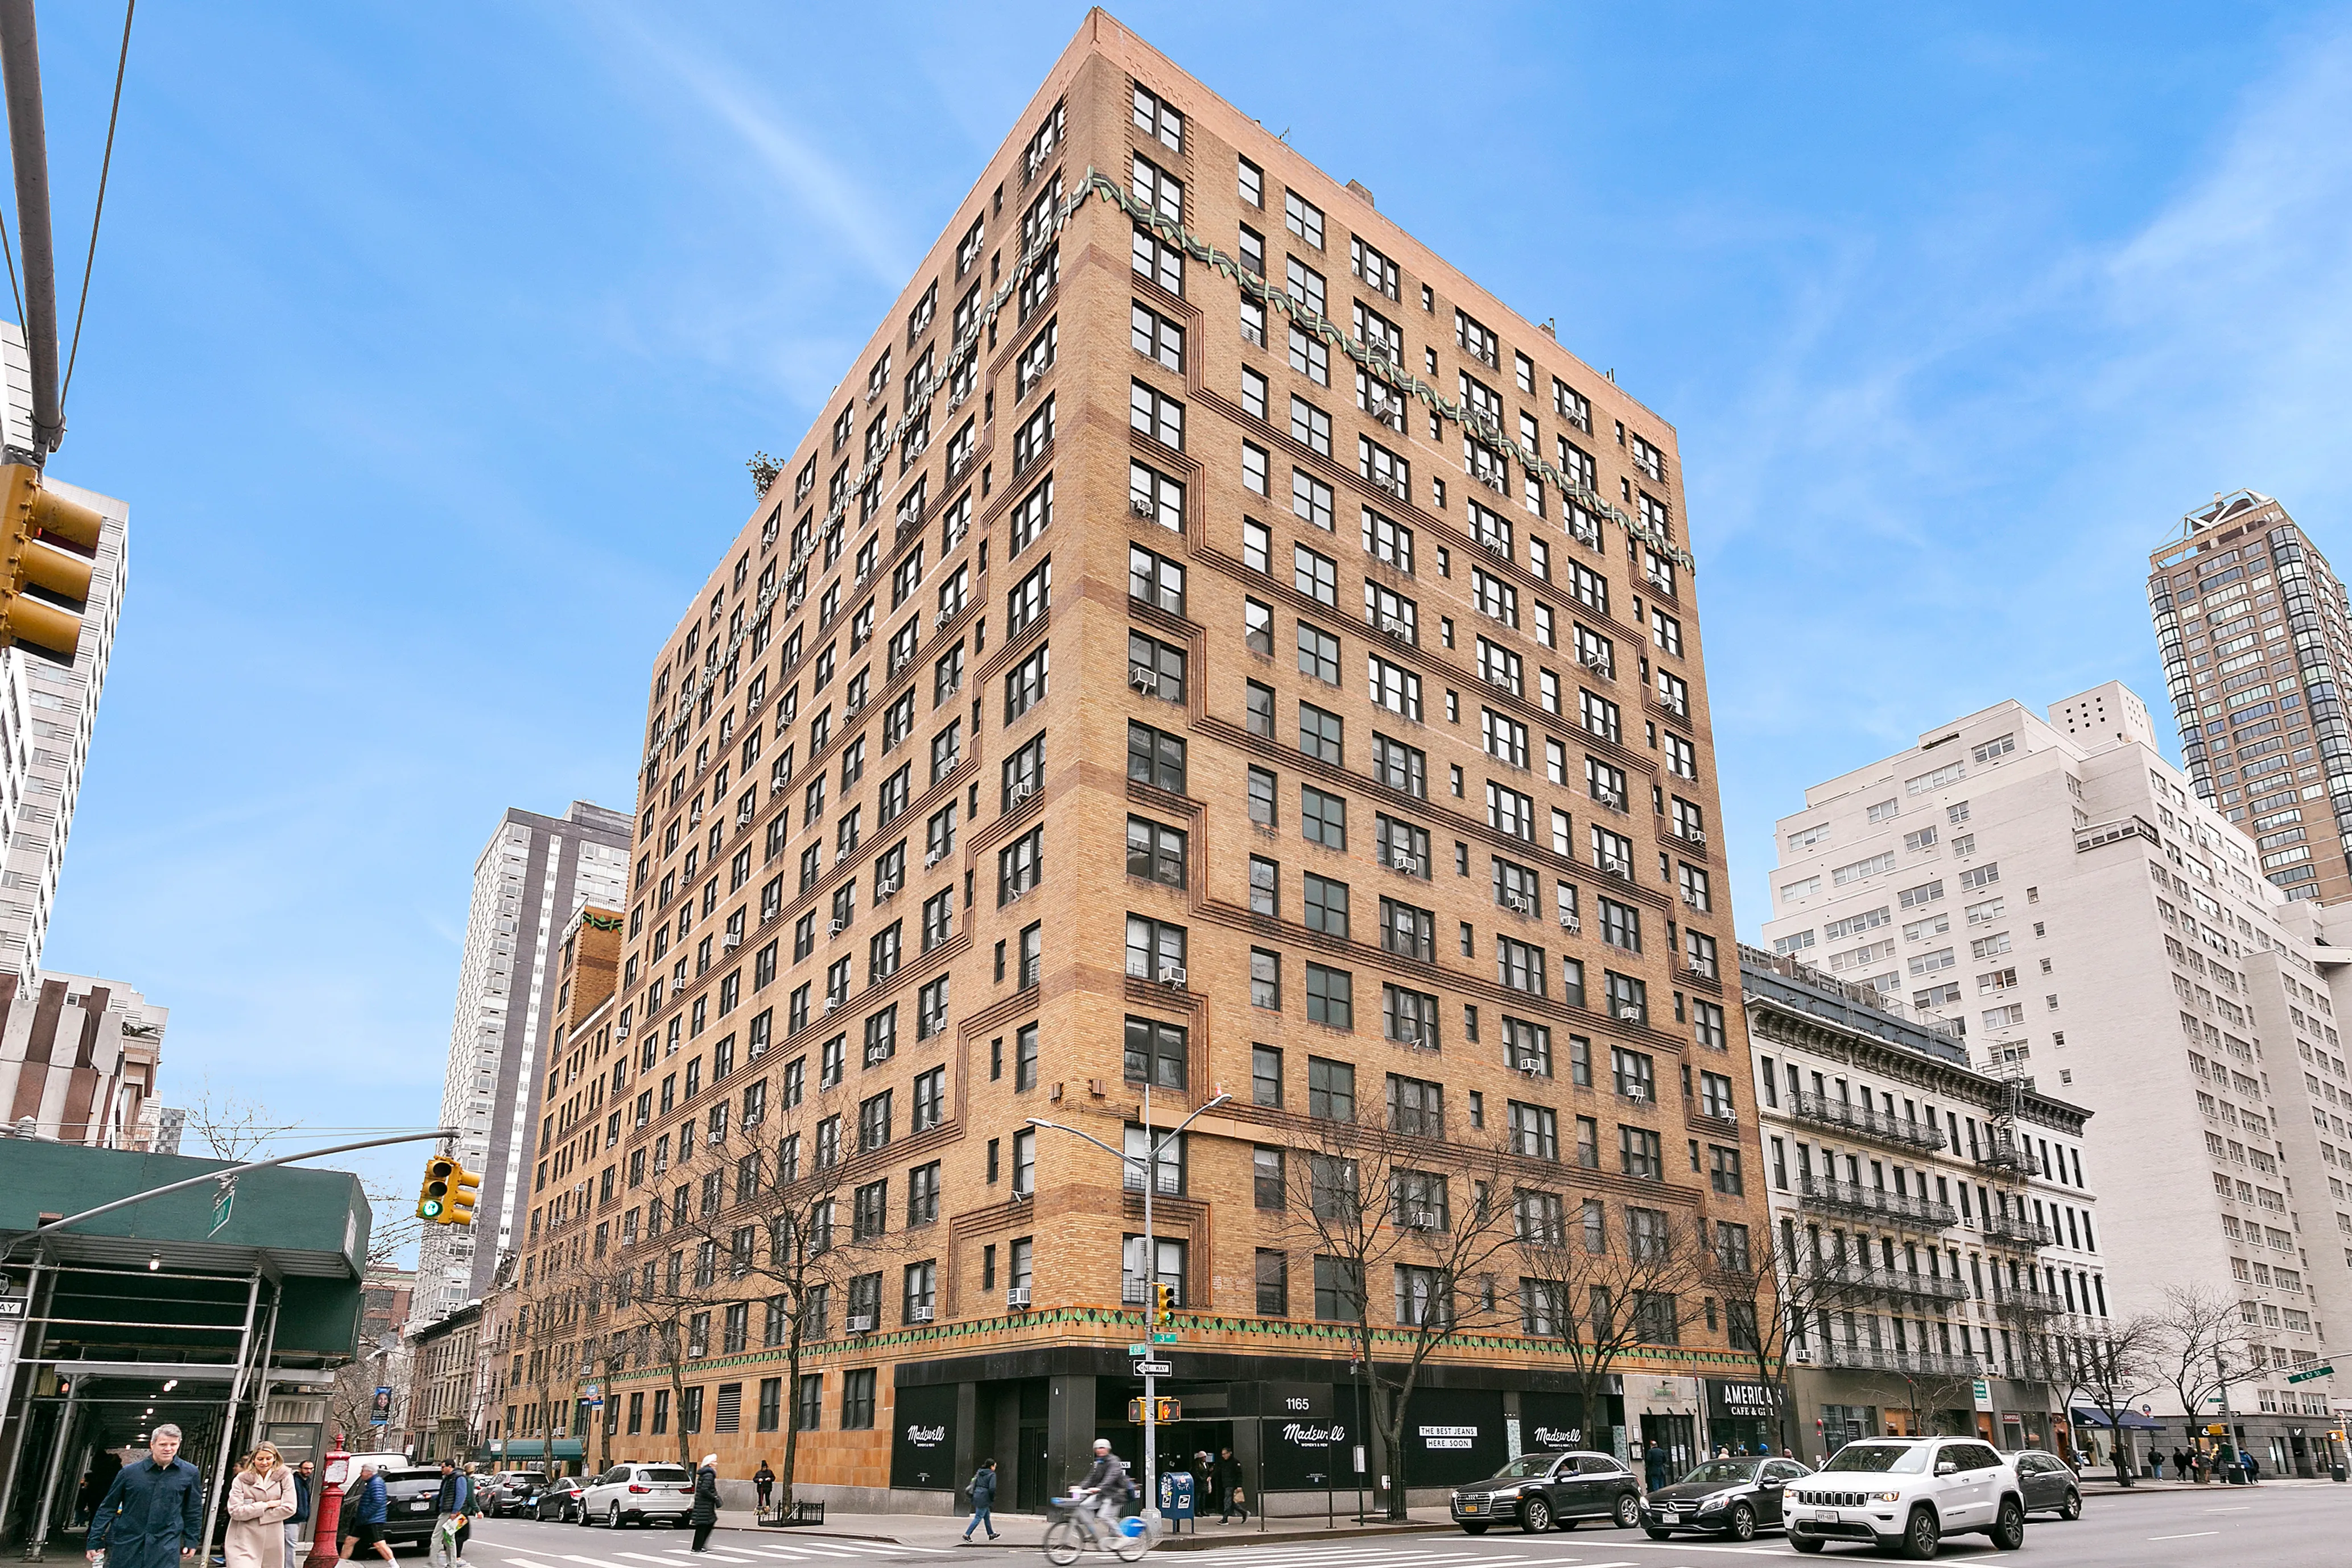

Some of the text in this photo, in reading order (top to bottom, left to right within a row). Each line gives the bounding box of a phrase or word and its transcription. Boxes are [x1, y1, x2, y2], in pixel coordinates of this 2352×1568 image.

[1286, 1398, 1310, 1410] 1165
[1724, 1385, 1782, 1405] AMERICAS
[1731, 1406, 1749, 1415] CAFE
[1751, 1407, 1757, 1416] &
[907, 1425, 945, 1445] Madewell
[1282, 1423, 1345, 1445] Madewll
[1534, 1427, 1581, 1445] Madewell
